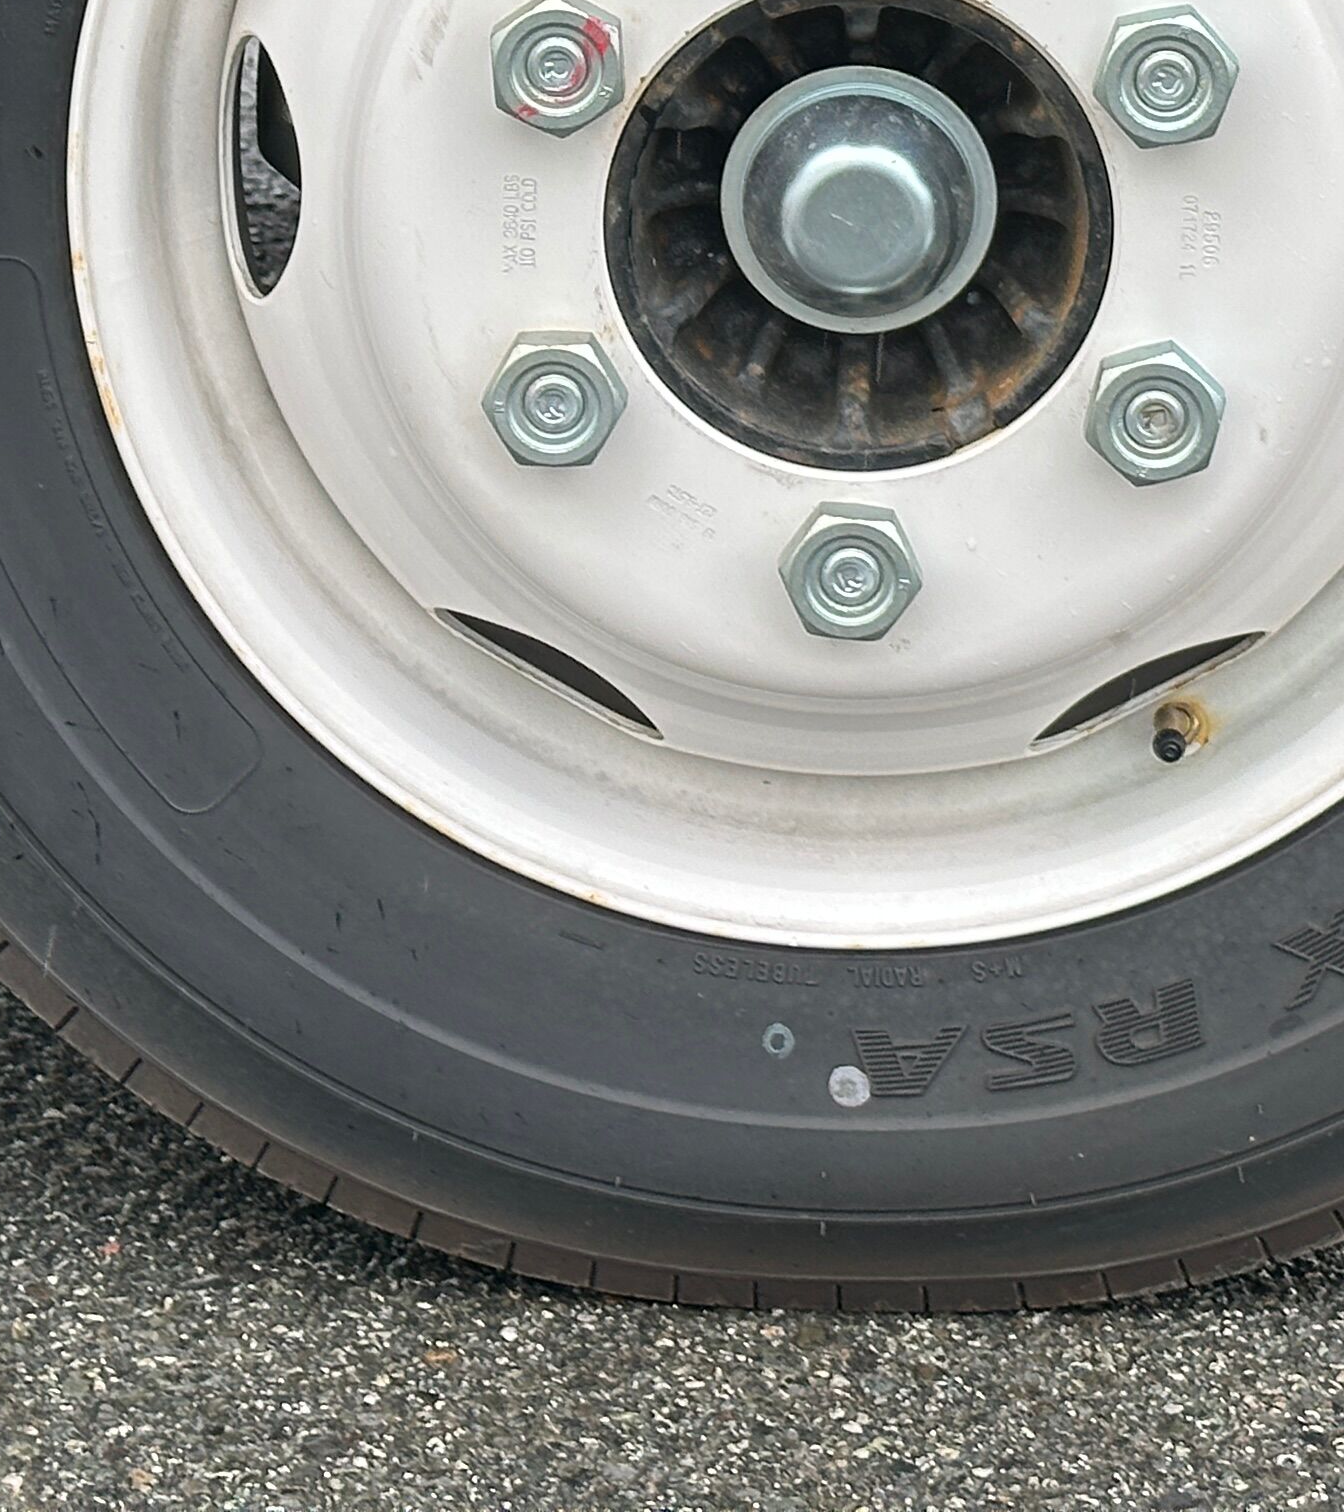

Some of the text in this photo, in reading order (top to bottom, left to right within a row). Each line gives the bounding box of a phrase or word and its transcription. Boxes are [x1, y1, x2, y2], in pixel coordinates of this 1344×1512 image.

[520, 177, 538, 213] COLD
[519, 218, 537, 242] PSI
[692, 952, 819, 988] TUBELESS
[855, 964, 926, 988] RADIAL
[851, 976, 1207, 1100] RSA
